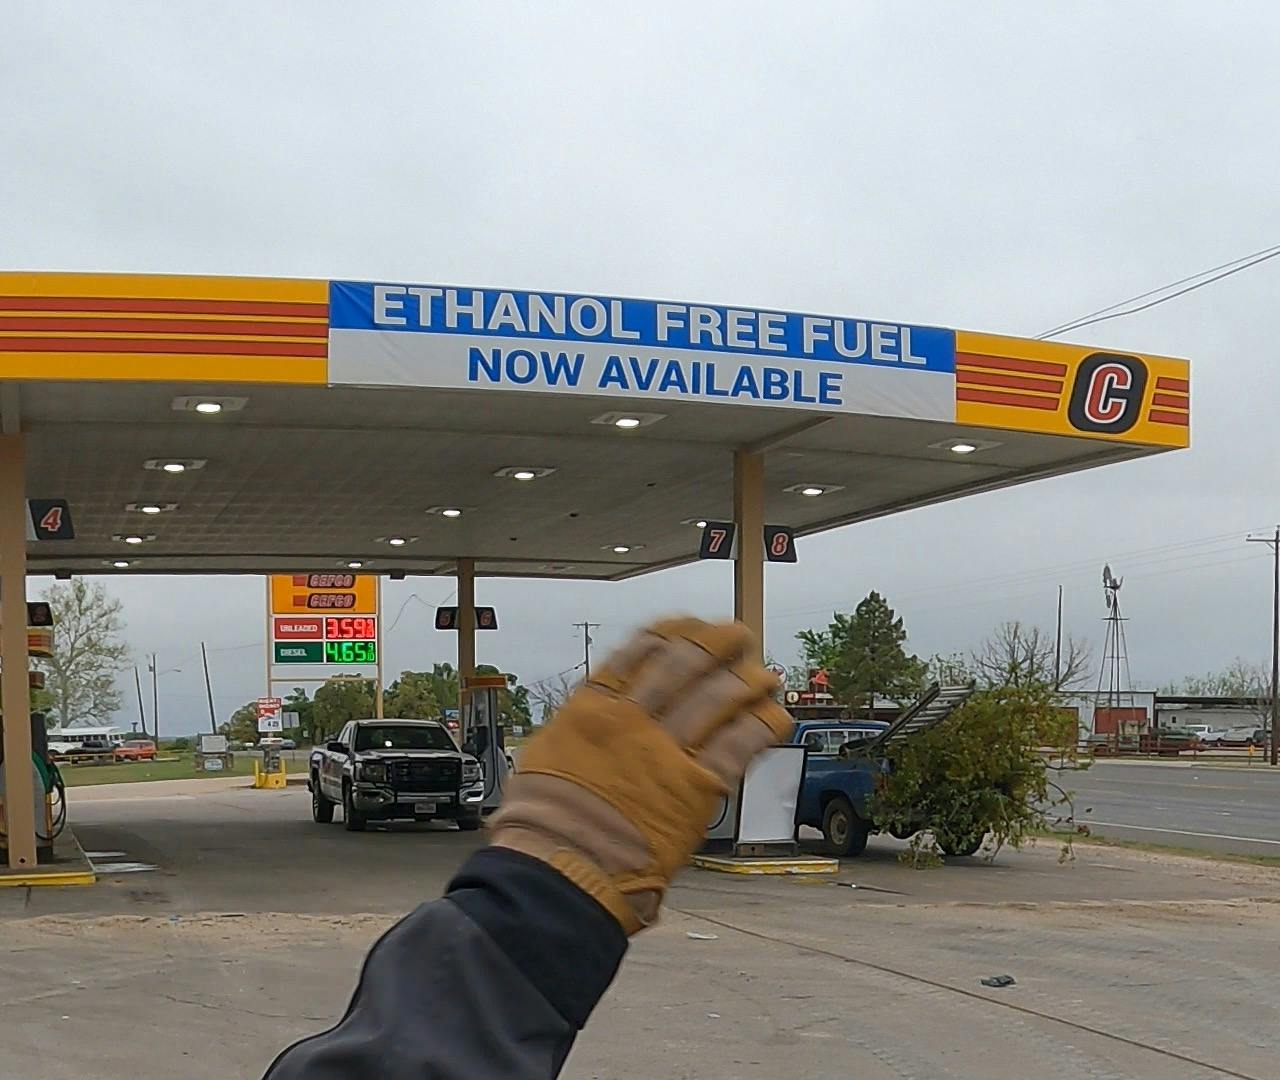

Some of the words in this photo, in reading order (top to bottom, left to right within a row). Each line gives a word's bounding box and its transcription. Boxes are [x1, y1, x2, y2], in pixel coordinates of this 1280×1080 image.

[373, 285, 641, 342] ETHANOL
[657, 302, 787, 353] FREE
[802, 316, 928, 366] FUEL
[467, 347, 590, 388] NOW
[598, 356, 845, 406] AVAILABLE
[1084, 361, 1133, 425] C
[40, 507, 63, 532] 4
[709, 529, 726, 553] 7
[771, 532, 789, 556] 8
[310, 594, 354, 607] CEFCO
[279, 624, 318, 632] UNLEADED
[480, 610, 493, 626] 6
[280, 648, 308, 657] DIESEL
